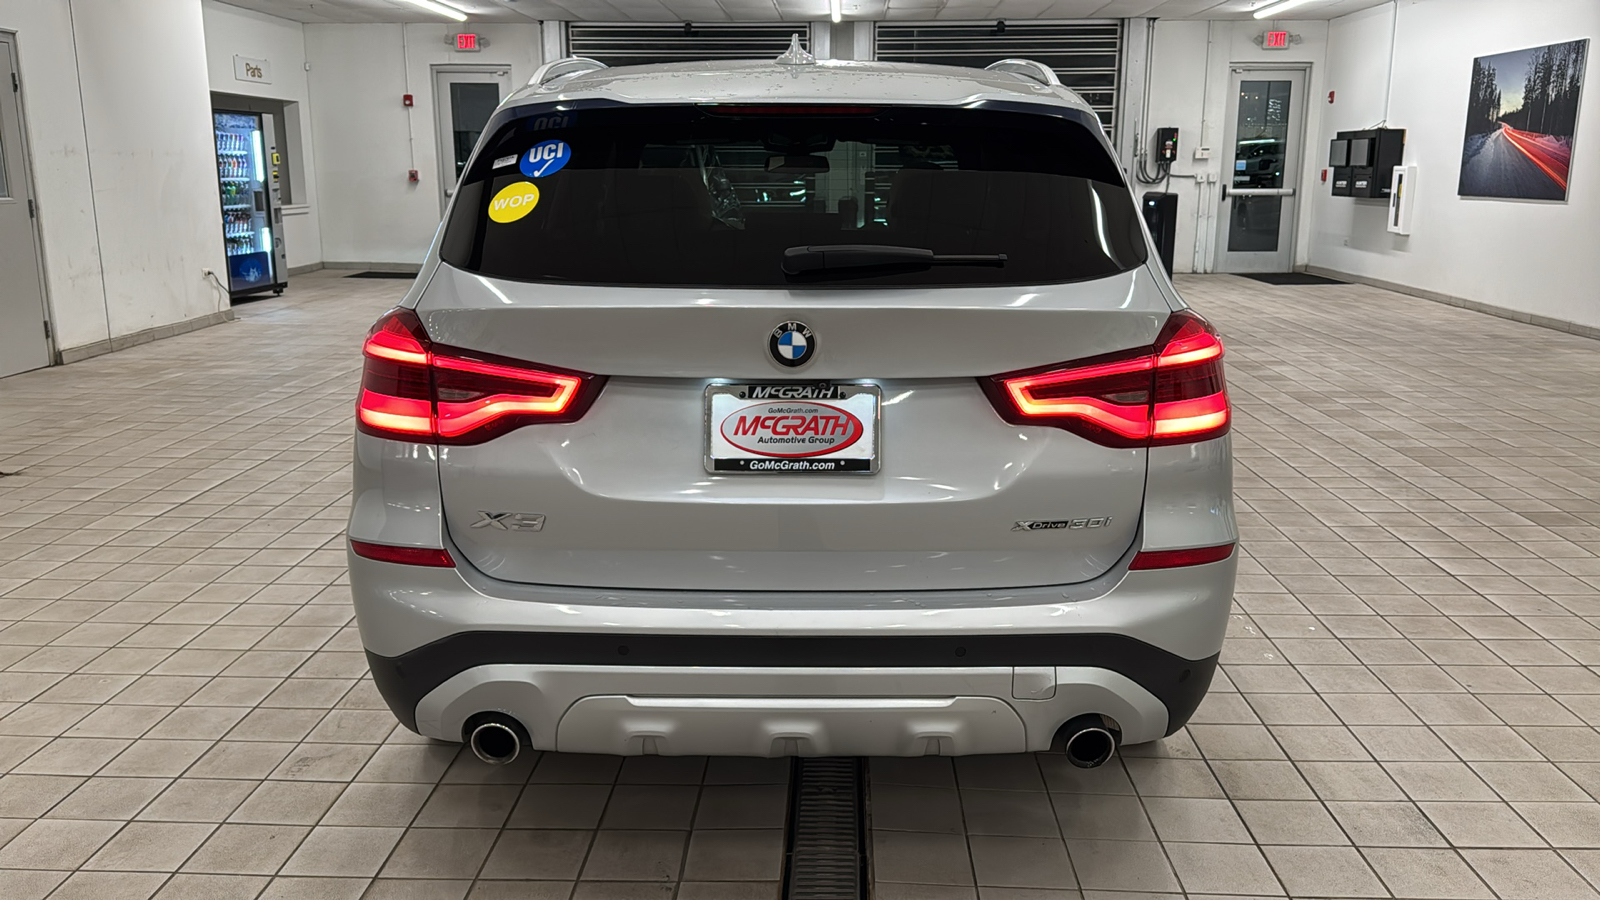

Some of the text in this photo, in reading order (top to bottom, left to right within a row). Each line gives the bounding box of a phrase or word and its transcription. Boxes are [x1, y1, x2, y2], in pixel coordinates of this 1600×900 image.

[457, 33, 476, 49] EXIT
[1267, 31, 1287, 47] EXIT
[245, 62, 263, 79] Parts
[529, 142, 564, 163] UCI
[493, 194, 535, 211] WOP
[773, 322, 812, 338] BMW
[757, 436, 835, 446] Automotive Group
[749, 460, 835, 470] GoMcGrath.com
[470, 510, 546, 532] X3
